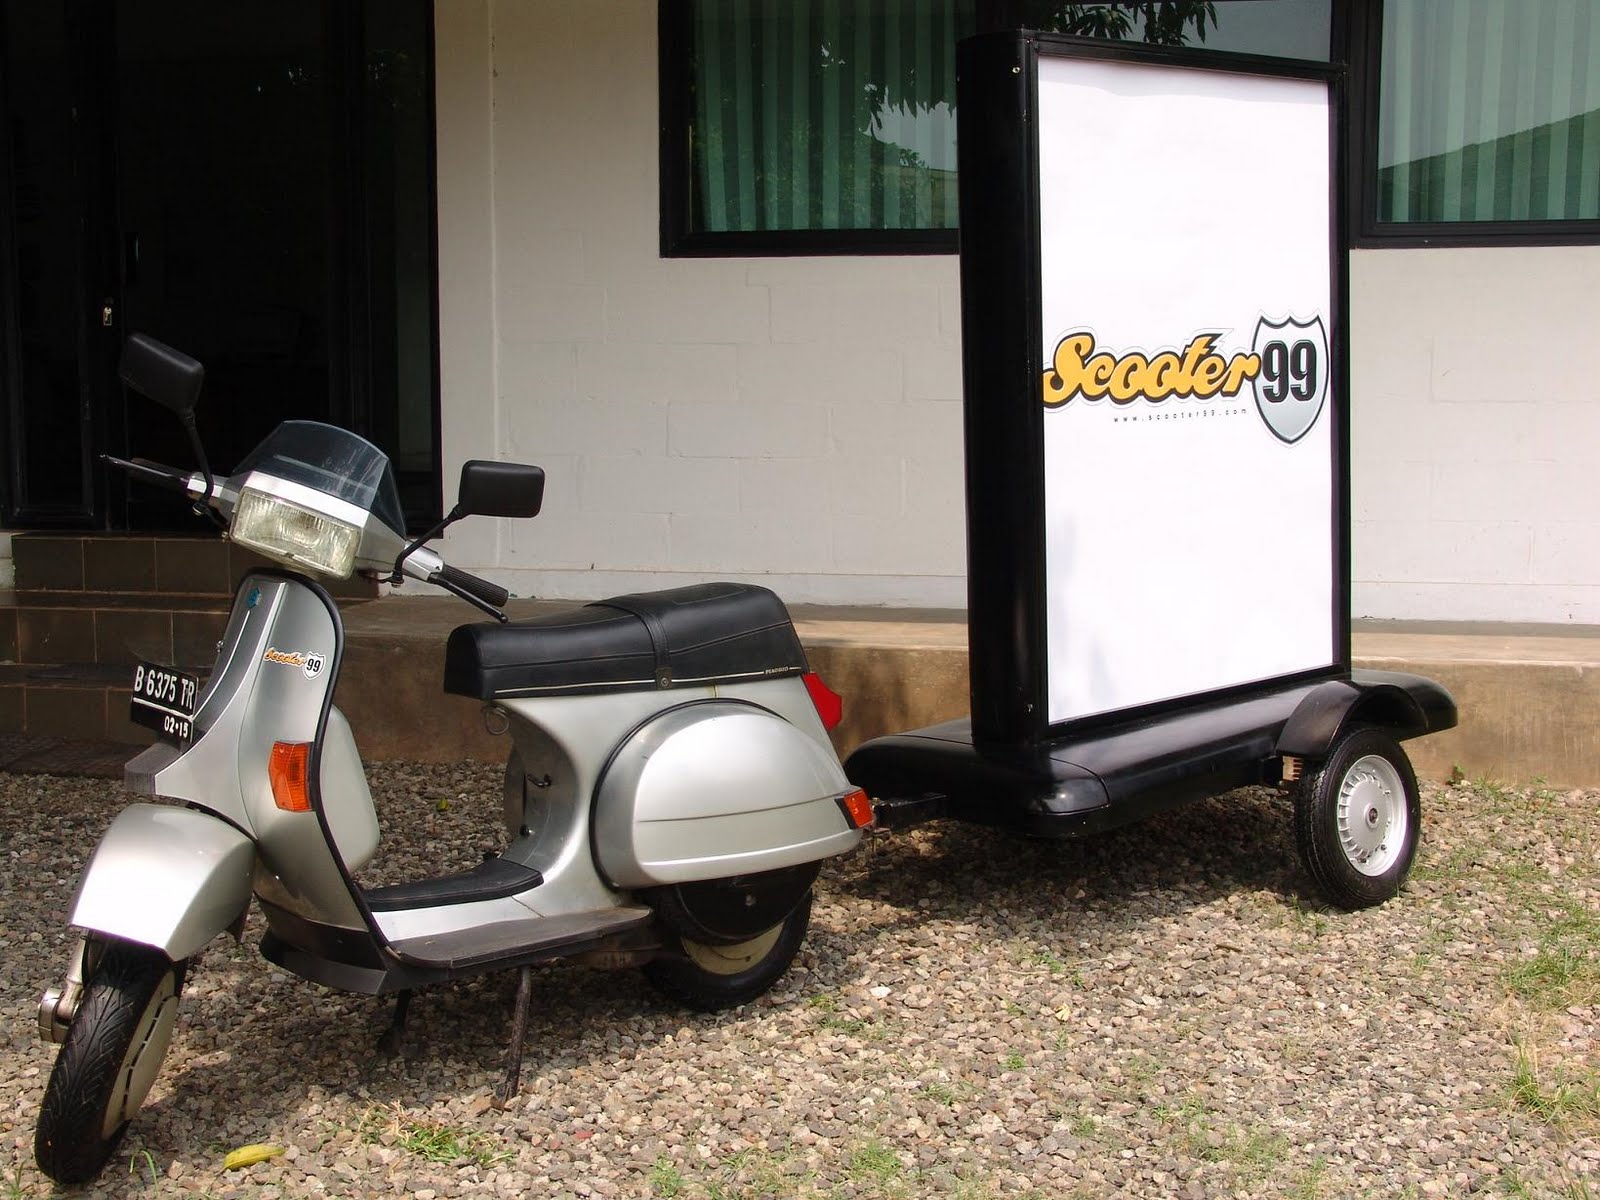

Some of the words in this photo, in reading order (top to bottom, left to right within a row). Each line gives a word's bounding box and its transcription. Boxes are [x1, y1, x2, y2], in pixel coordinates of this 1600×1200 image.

[1042, 332, 1261, 408] Scooter
[1262, 339, 1317, 403] 99
[134, 665, 143, 692] B
[146, 671, 177, 703] 6375
[181, 678, 195, 710] TR
[306, 658, 322, 673] 99
